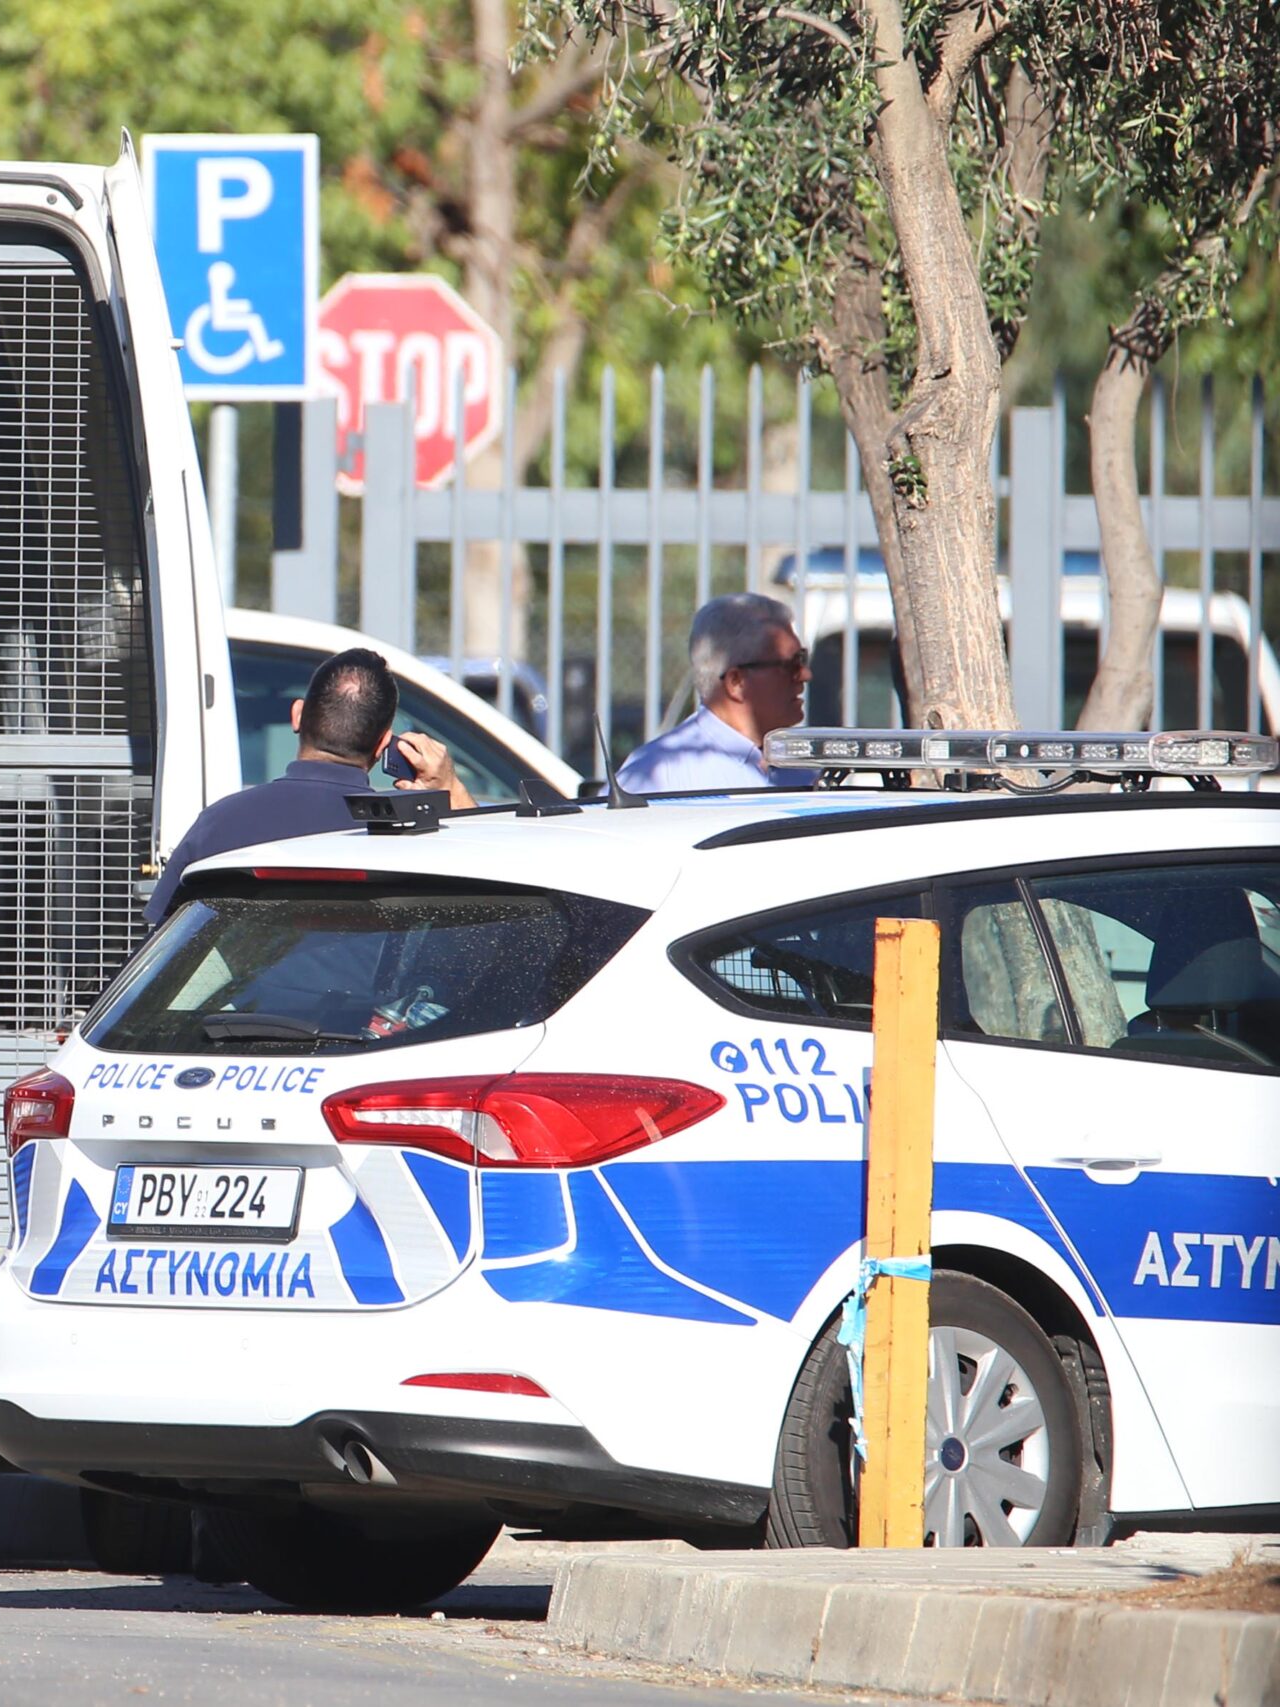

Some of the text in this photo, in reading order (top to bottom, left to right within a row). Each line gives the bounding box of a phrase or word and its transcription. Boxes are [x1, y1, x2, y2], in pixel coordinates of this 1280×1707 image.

[197, 156, 274, 254] P
[316, 330, 488, 438] STOP
[83, 1063, 326, 1094] POLICE POLICE
[750, 1038, 837, 1076] 112
[114, 1202, 128, 1215] CY
[137, 1173, 268, 1219] PBY 224
[94, 1248, 316, 1298] ΑΣΤΥΝΟΜΙΑ
